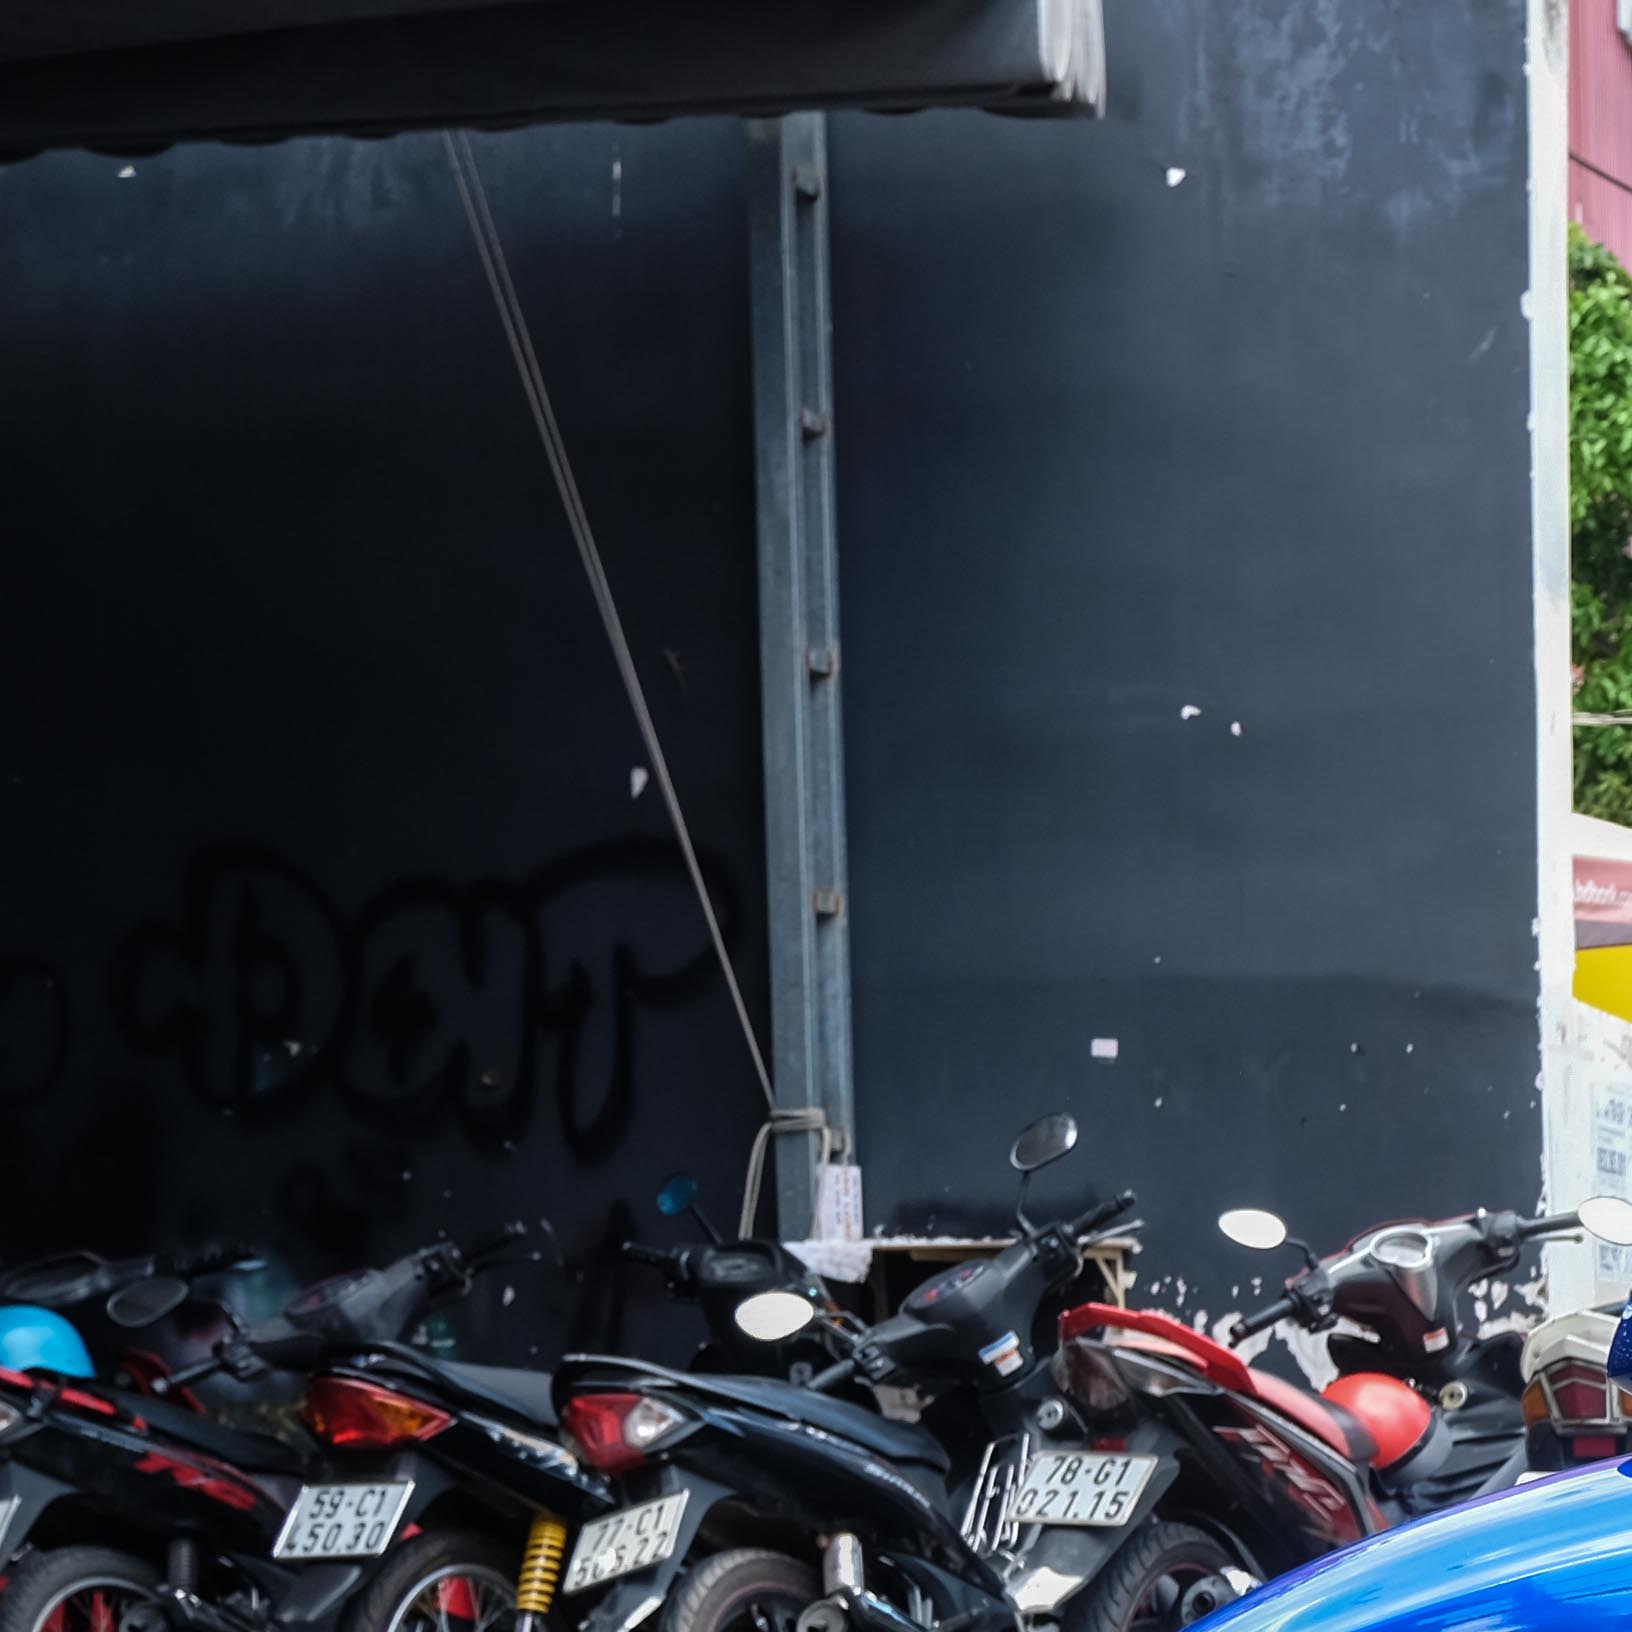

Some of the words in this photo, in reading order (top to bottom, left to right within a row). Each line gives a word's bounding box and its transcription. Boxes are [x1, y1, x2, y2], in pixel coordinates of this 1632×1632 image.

[1045, 1455, 1132, 1488] 78-G1
[308, 1488, 389, 1520] 59-C1
[1015, 1488, 1130, 1520] 021.15
